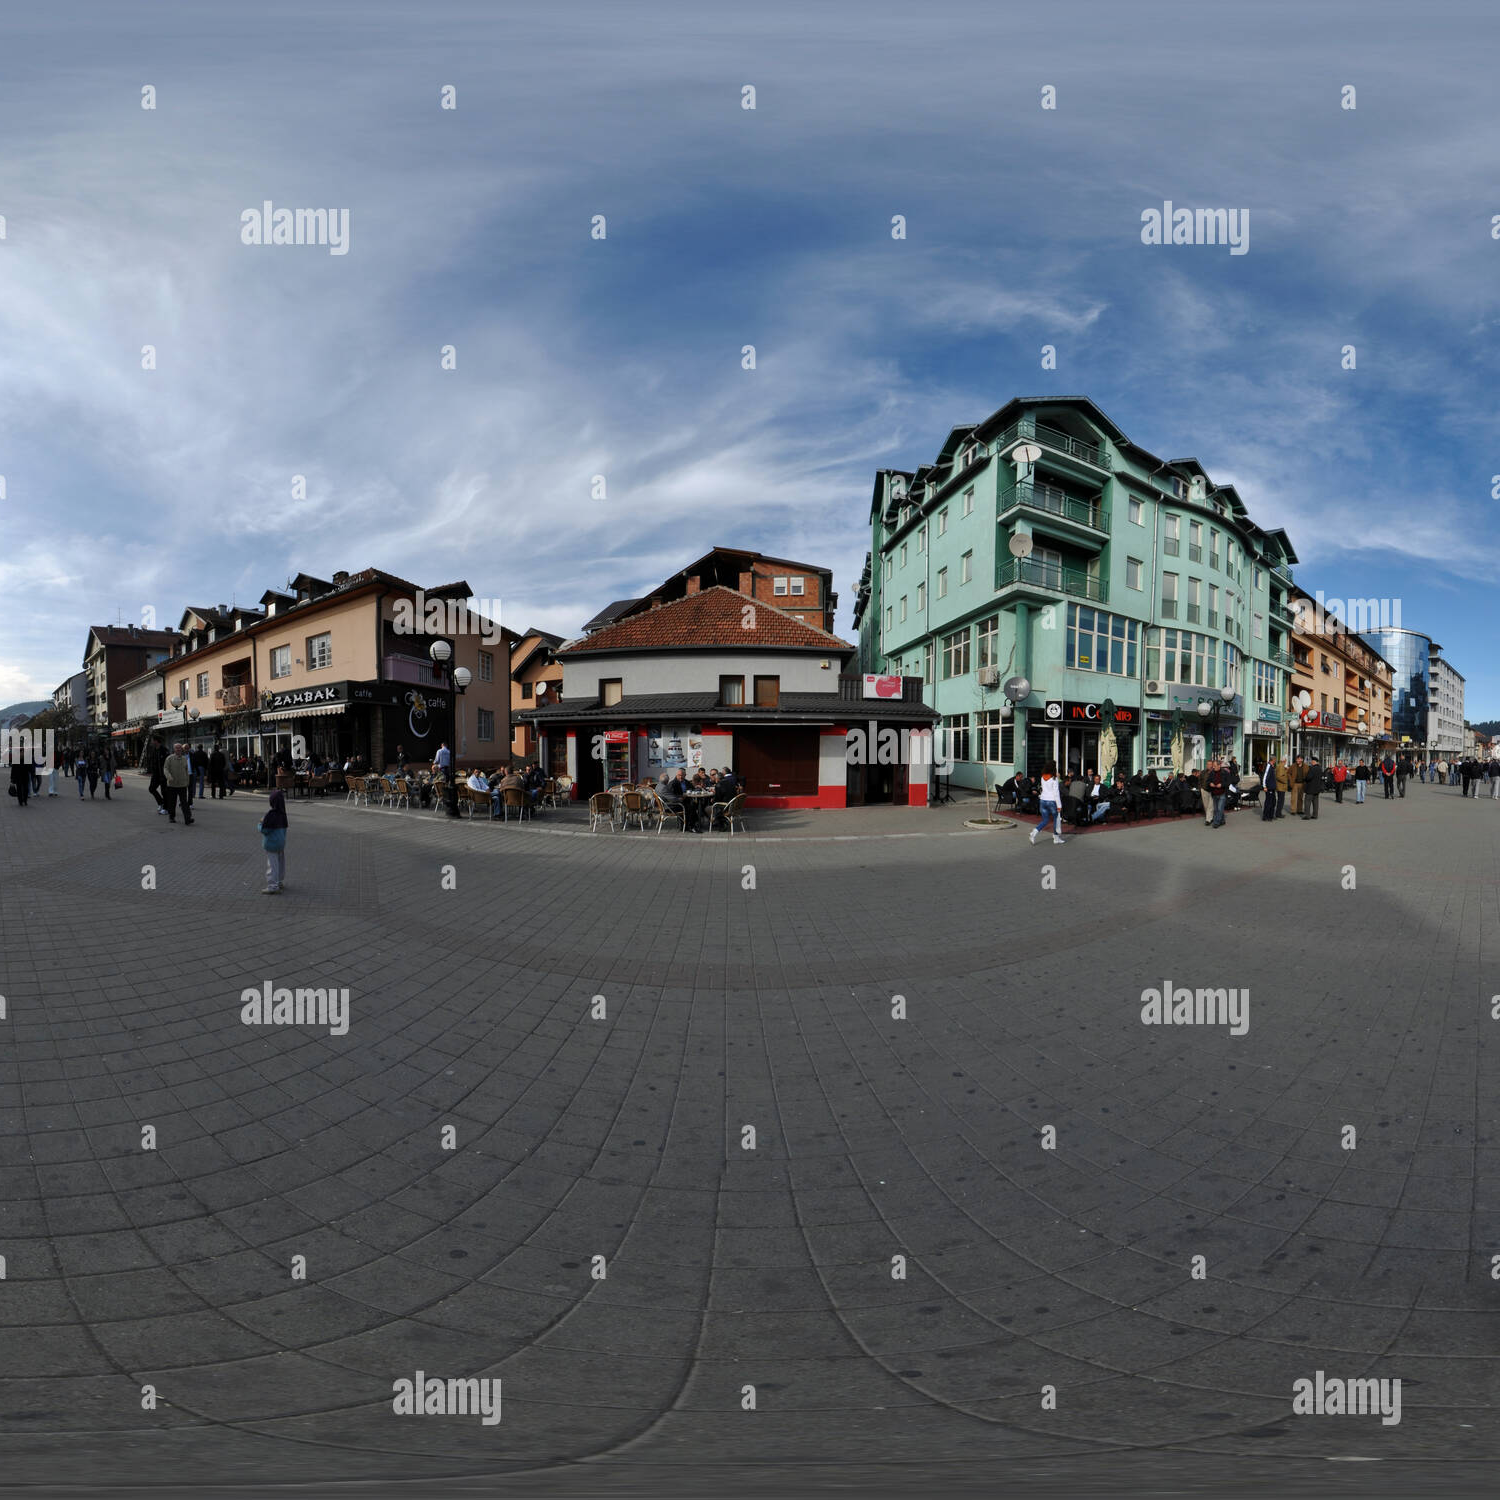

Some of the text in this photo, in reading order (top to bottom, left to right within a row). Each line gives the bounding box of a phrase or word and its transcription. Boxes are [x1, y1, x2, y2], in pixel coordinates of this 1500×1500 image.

[275, 688, 335, 706] ZAMBAK
[354, 689, 373, 698] caffe
[428, 698, 446, 709] caffe
